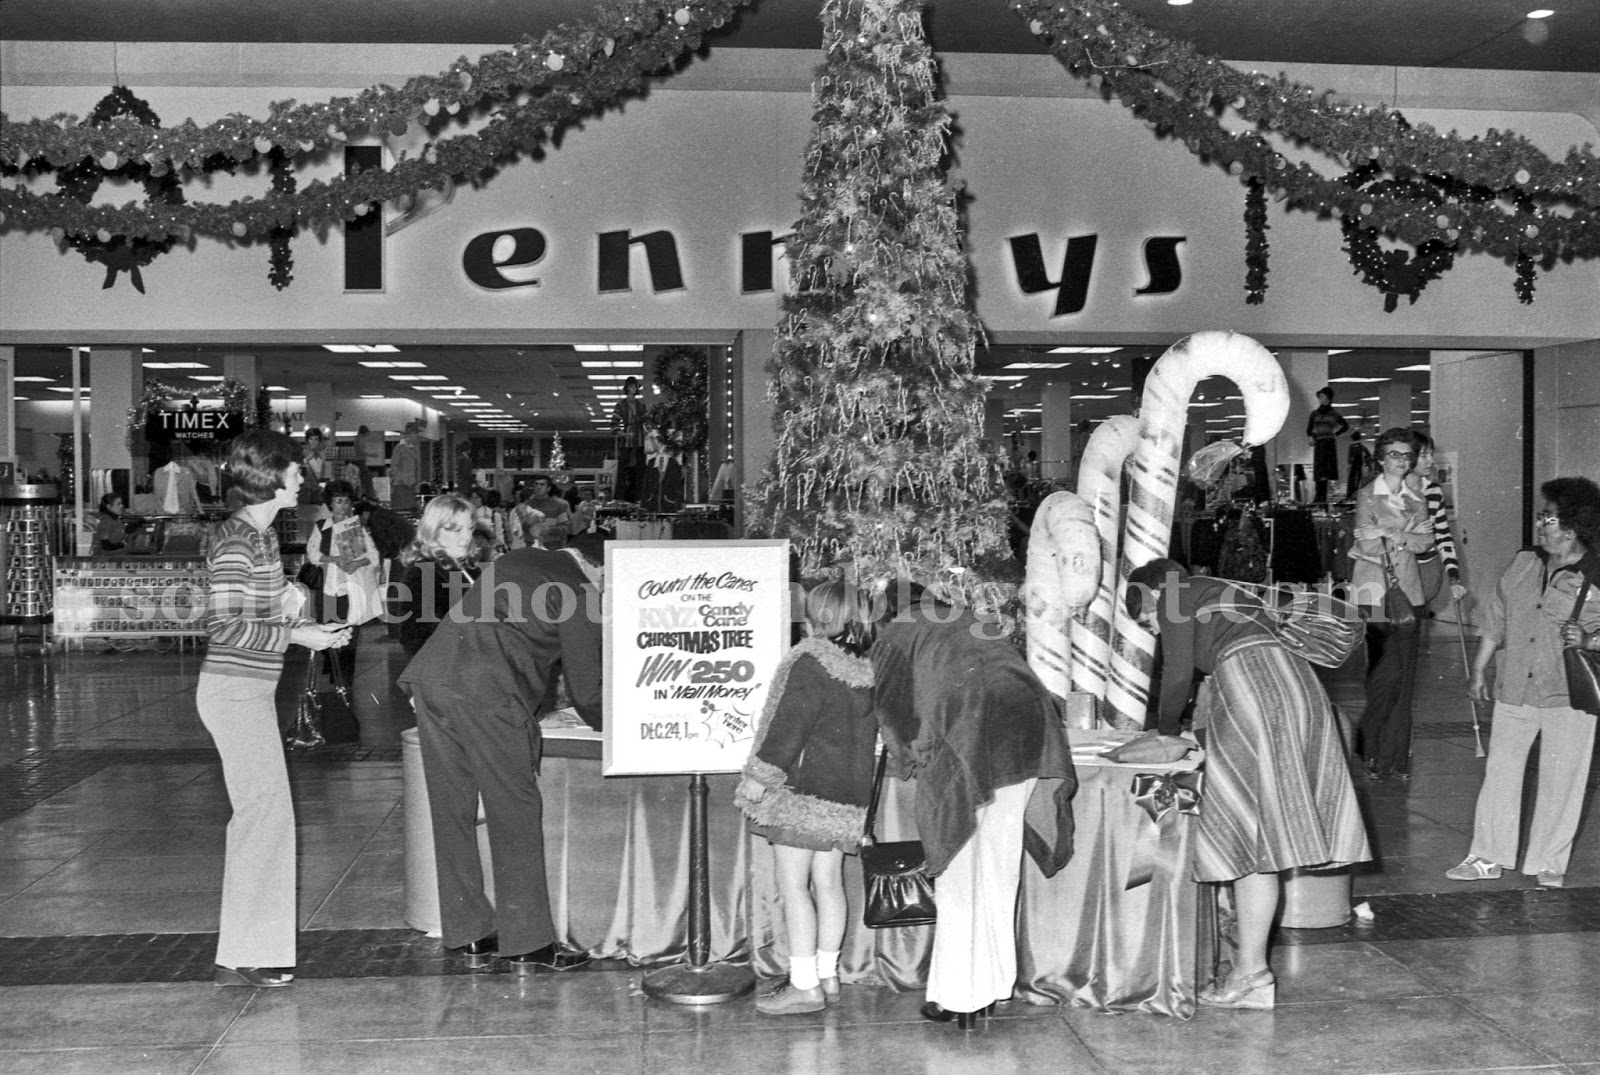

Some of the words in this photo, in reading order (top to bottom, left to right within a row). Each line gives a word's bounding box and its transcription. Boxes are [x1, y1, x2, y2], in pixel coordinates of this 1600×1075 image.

[159, 411, 231, 430] TIMEX
[174, 431, 215, 440] WATCHES
[638, 575, 693, 600] Count
[690, 571, 717, 590] the
[715, 571, 758, 592] Canes
[680, 593, 696, 602] ON
[697, 593, 713, 602] THE
[698, 602, 754, 619] Candy
[703, 615, 748, 627] Cane
[636, 630, 720, 654] CHRISTMAS
[720, 629, 754, 650] TREE
[653, 689, 668, 700] IN
